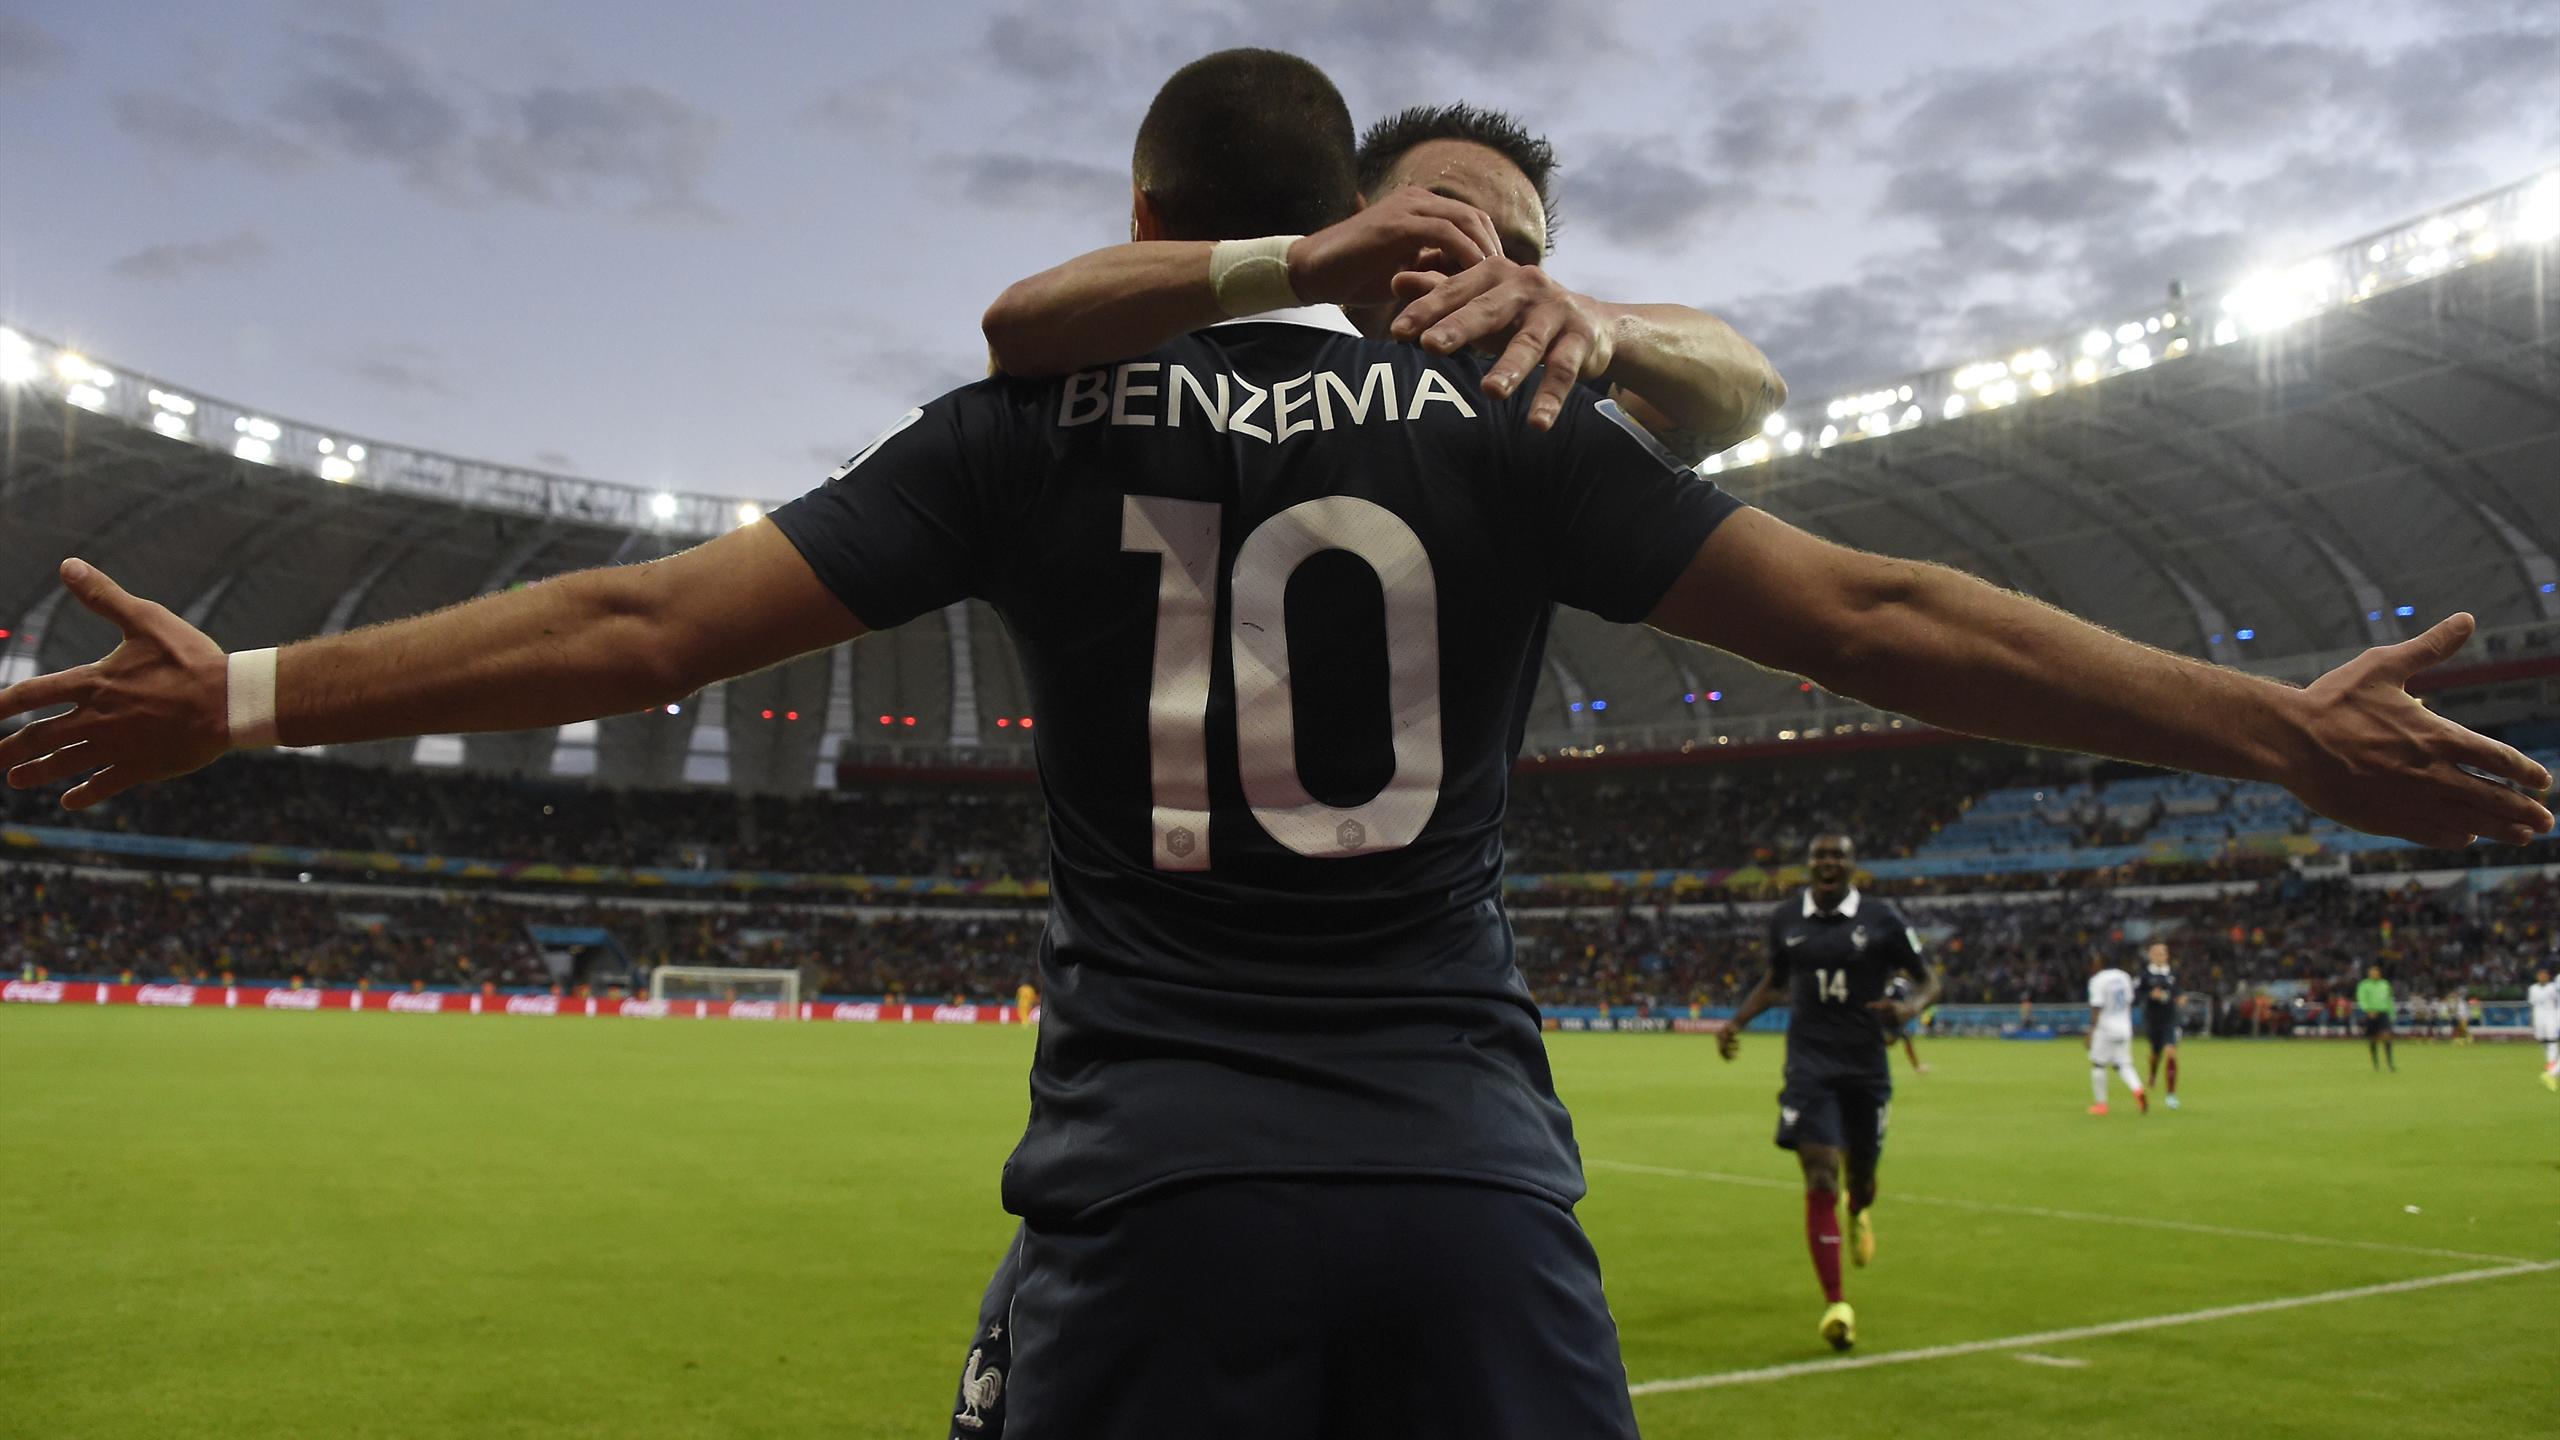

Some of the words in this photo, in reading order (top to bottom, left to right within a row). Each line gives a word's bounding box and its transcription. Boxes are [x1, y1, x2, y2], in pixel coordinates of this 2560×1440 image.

[1057, 363, 1477, 444] BENZEMA
[1121, 495, 1443, 871] 10
[1815, 968, 1849, 1003] 14
